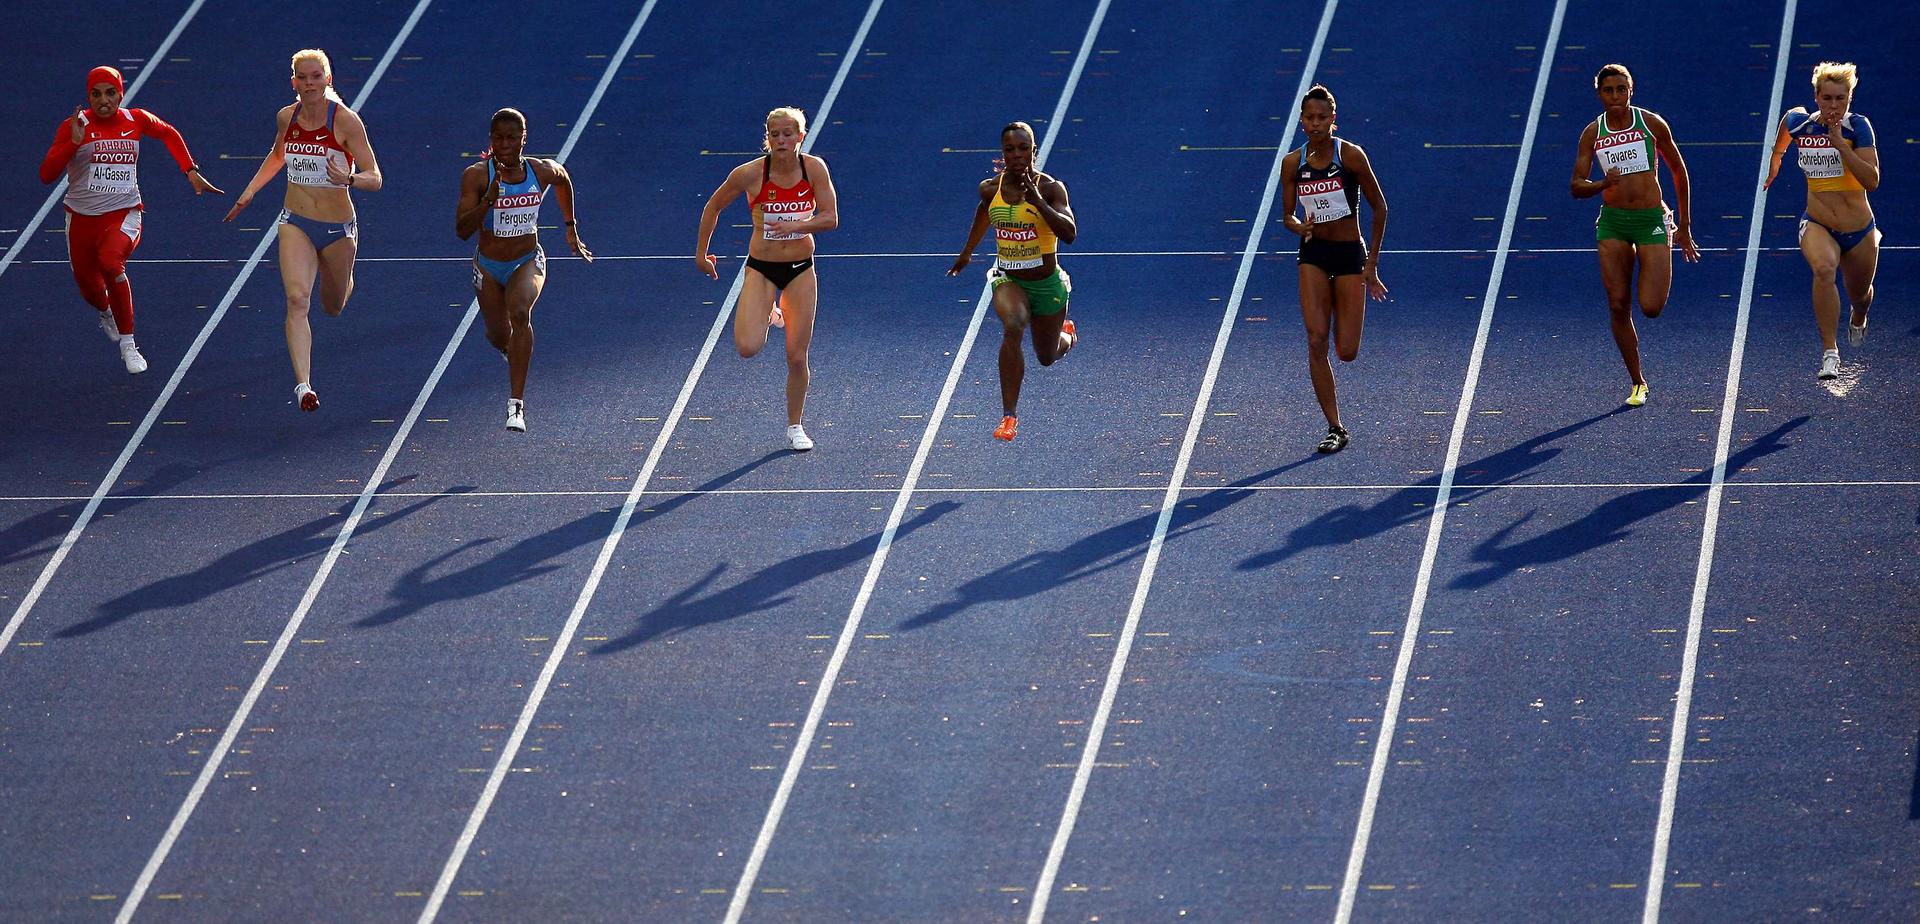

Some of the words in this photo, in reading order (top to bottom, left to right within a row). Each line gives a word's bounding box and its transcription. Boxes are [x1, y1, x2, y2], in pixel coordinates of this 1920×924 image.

[1598, 132, 1645, 147] TOYOTA
[1799, 137, 1831, 147] TOYOT
[94, 141, 135, 151] BAHRAIN
[288, 143, 325, 154] TOYOTA
[93, 153, 135, 162] TOYOTA
[1605, 149, 1638, 164] Tavares
[93, 166, 130, 181] Al-Gassra
[1806, 169, 1823, 177] erlin
[1299, 180, 1340, 194] TOYOTA
[497, 195, 540, 207] TOYOTA
[766, 201, 811, 212] TOYOTA
[1314, 198, 1330, 210] Lee
[1316, 213, 1331, 222] rlin
[996, 228, 1037, 240] TOYOTA
